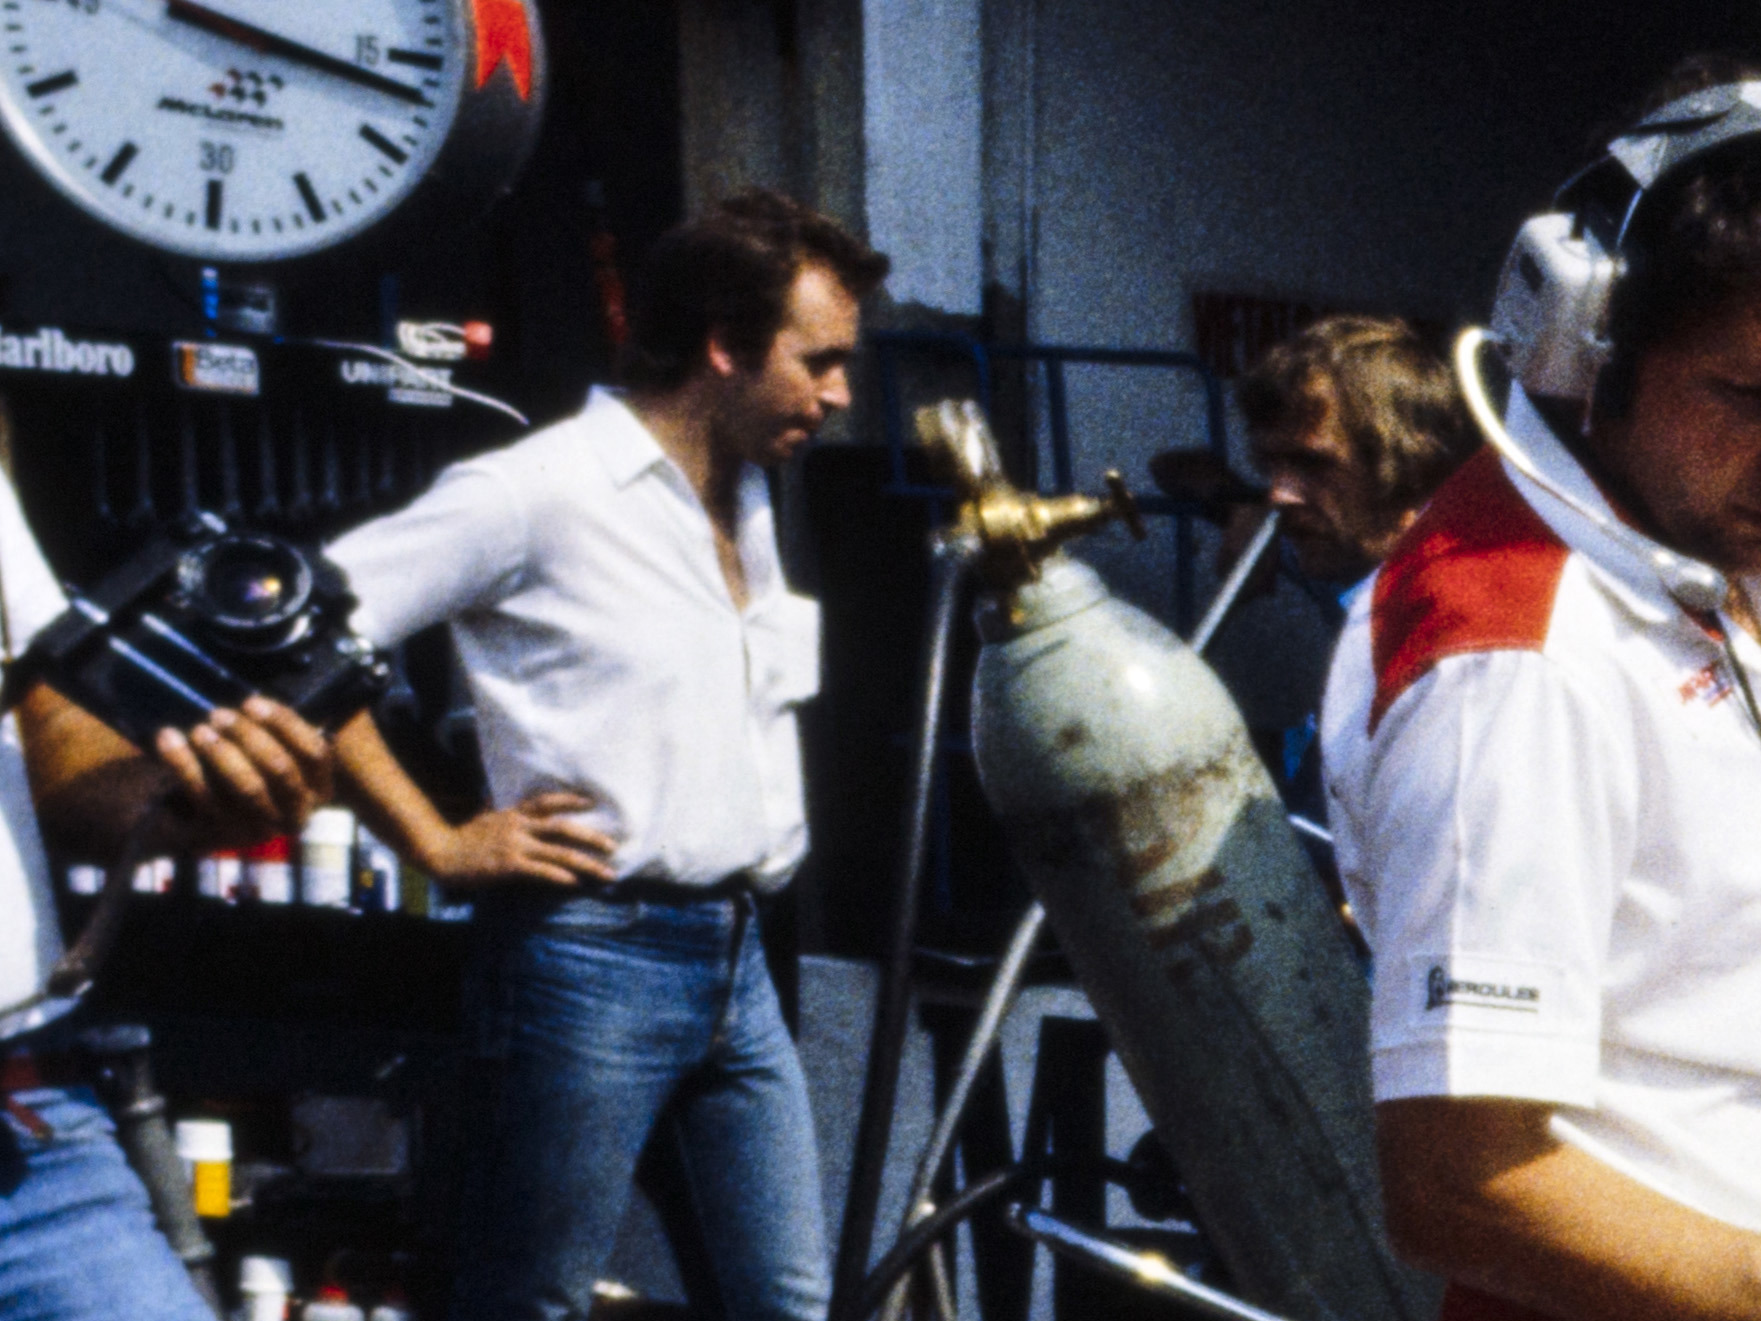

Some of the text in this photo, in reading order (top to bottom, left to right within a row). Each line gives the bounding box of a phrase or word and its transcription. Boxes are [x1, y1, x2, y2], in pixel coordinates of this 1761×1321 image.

[355, 34, 380, 66] 15
[201, 141, 234, 174] 30
[0, 327, 135, 378] arlboro
